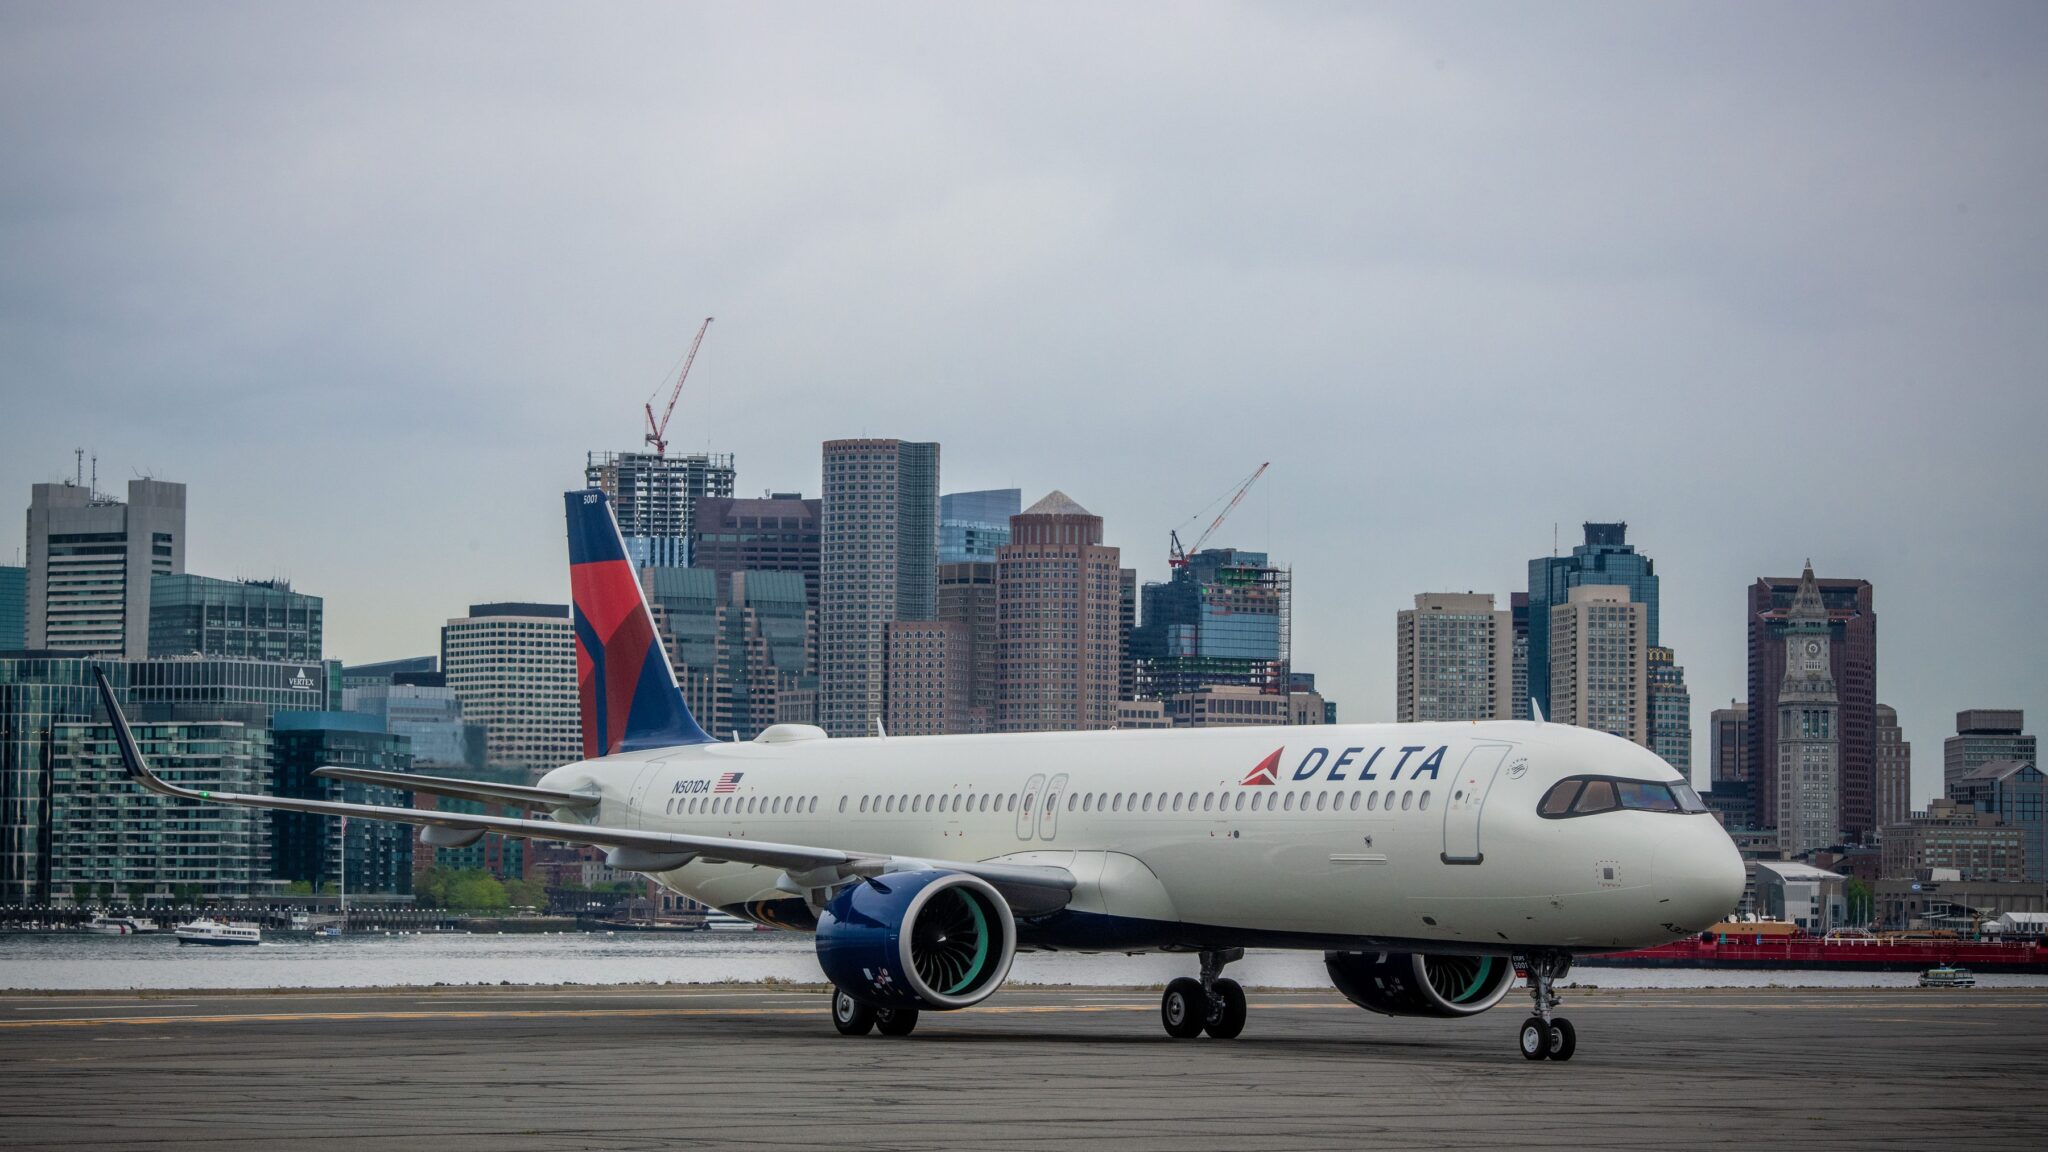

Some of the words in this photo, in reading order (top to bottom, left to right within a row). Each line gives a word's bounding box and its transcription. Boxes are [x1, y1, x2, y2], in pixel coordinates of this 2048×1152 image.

[583, 494, 598, 504] 5001
[288, 677, 314, 686] VERTEX
[1292, 745, 1449, 781] DELTA
[671, 779, 711, 794] N501DA
